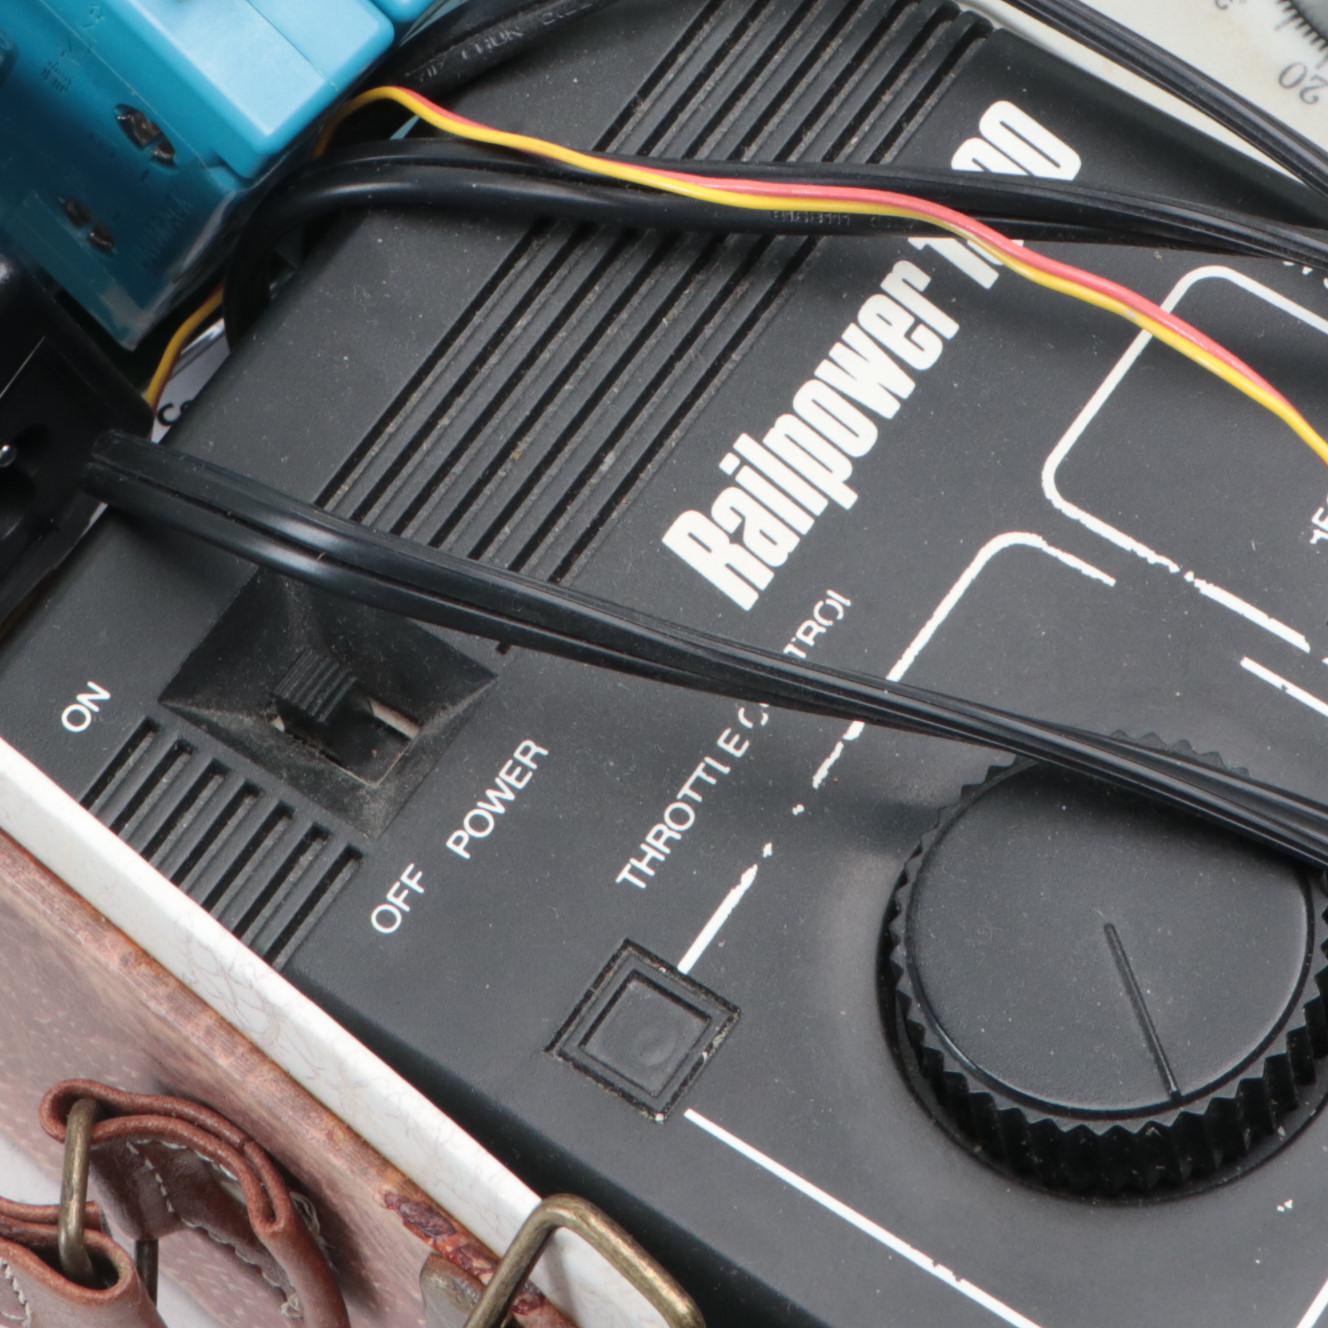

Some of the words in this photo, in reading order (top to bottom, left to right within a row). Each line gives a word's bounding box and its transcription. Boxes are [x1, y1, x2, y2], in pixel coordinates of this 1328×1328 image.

[661, 259, 961, 613] Railpower
[59, 679, 112, 735] ON
[369, 862, 427, 937] OFF
[444, 737, 550, 862] POWER
